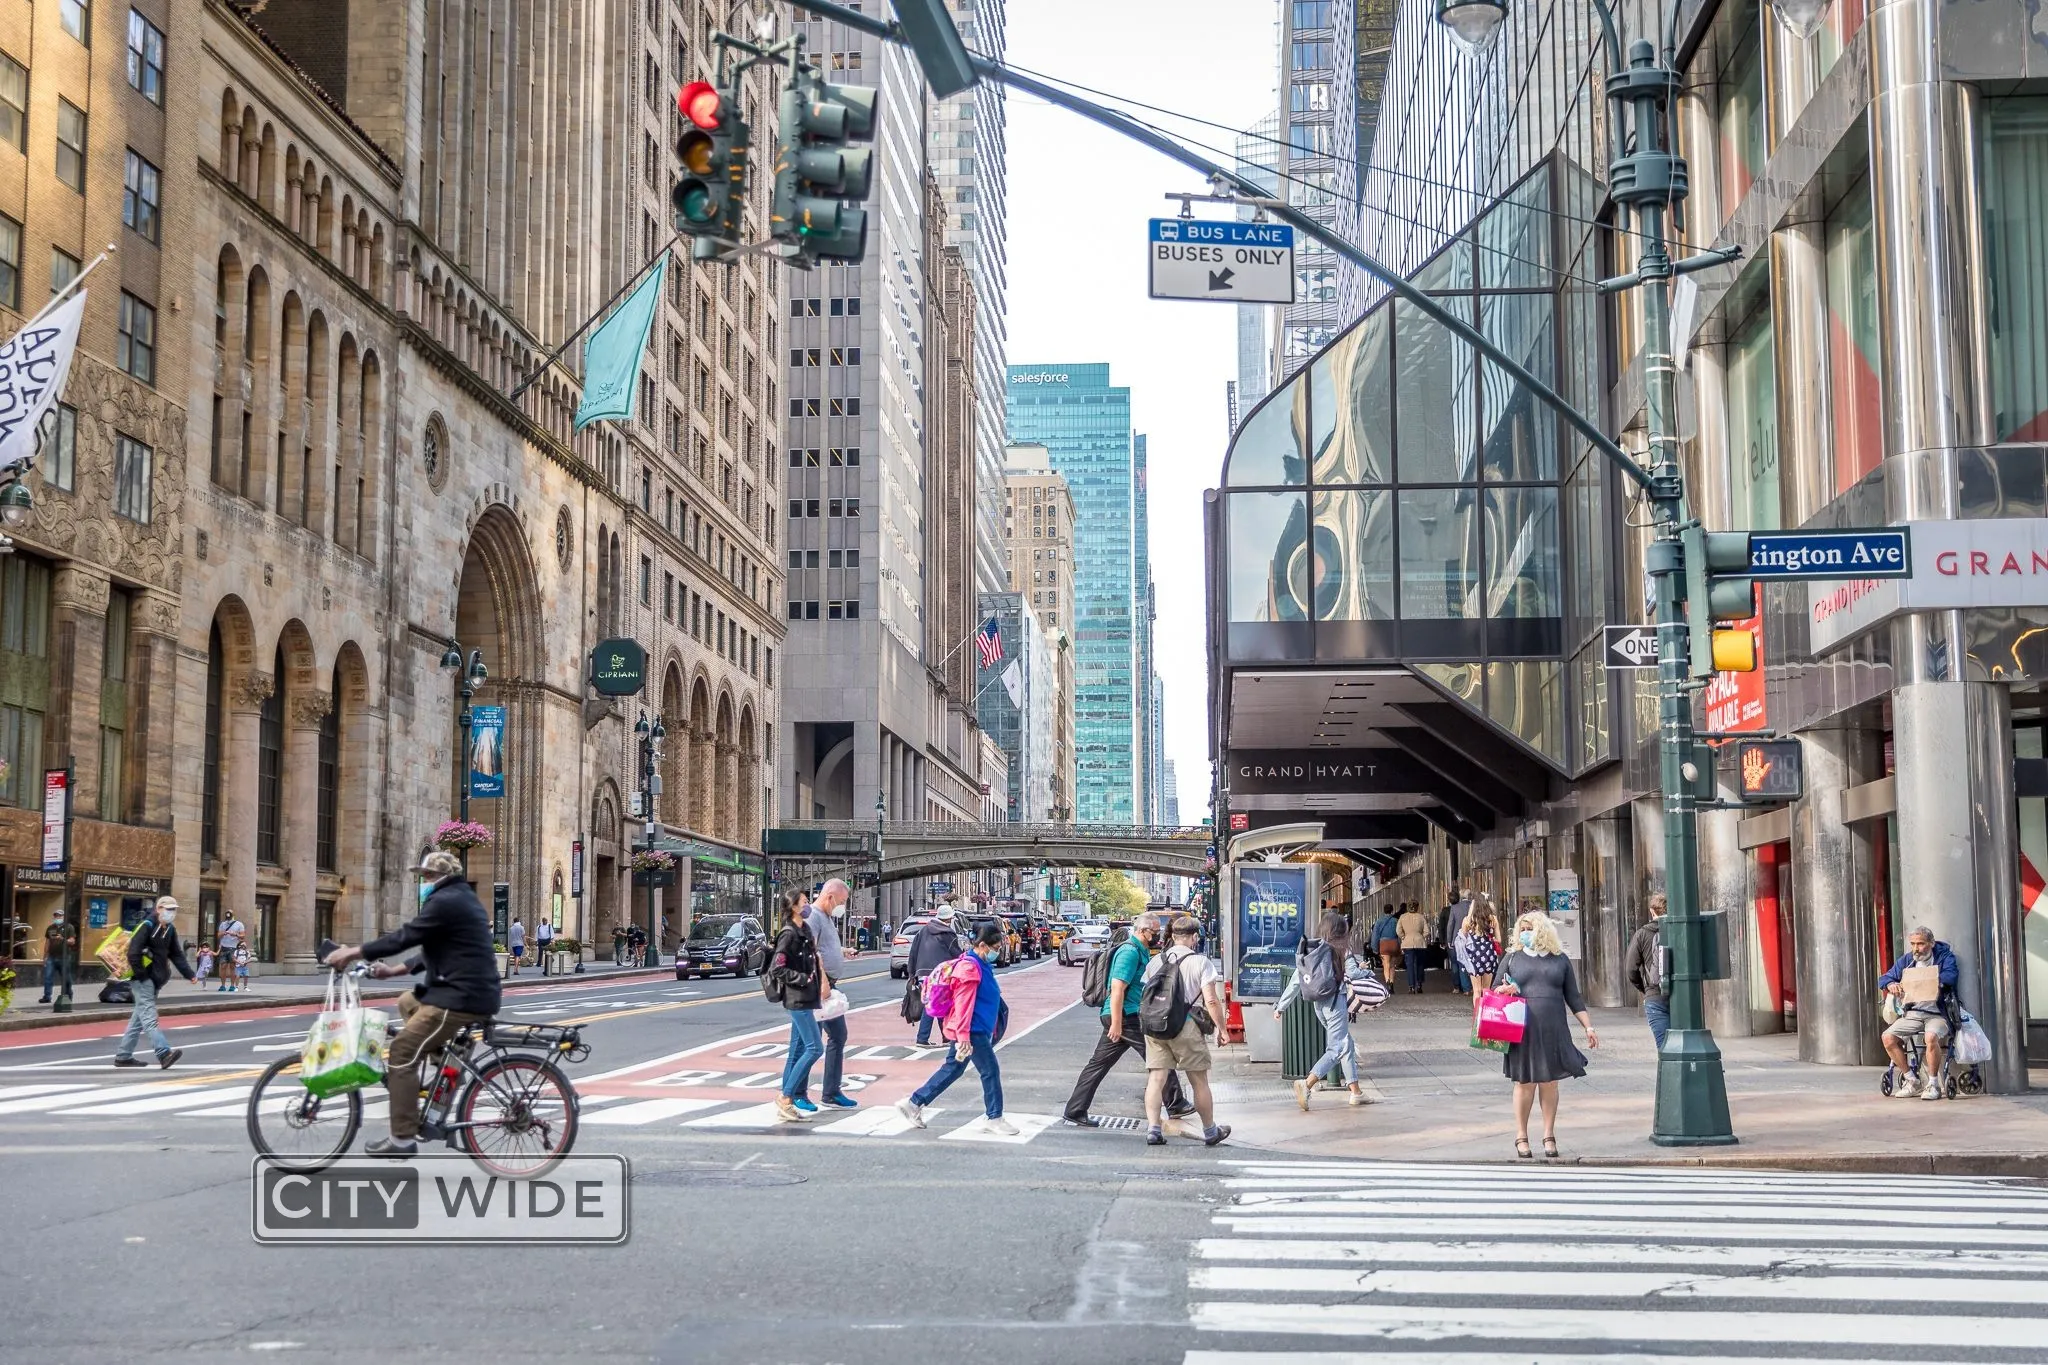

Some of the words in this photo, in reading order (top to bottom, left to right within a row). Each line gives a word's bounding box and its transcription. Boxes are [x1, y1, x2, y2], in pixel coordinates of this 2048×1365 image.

[1188, 226, 1224, 239] BUS
[1232, 228, 1283, 242] LANE
[1158, 245, 1224, 263] BUSES
[1235, 249, 1285, 265] ONLY
[1011, 372, 1069, 385] salesforce
[1850, 542, 1900, 564] Ave
[1813, 584, 1848, 623] GRAND
[1625, 639, 1658, 655] ONE
[598, 671, 638, 679] CIPRIANI
[1707, 671, 1739, 706] SPACE
[1708, 698, 1740, 733] AVAILABLE
[1240, 765, 1304, 777] GRAND
[1316, 765, 1377, 777] HYATT
[925, 852, 966, 862] SQUARE
[973, 849, 1007, 857] PLAZA
[1067, 849, 1105, 857] GRAND
[1111, 852, 1161, 862] CENTRAL
[1168, 857, 1202, 868] TERMI
[86, 874, 104, 887] APPLE
[104, 875, 121, 888] BANK
[128, 878, 152, 891] SAVINGS
[1248, 901, 1298, 917] STOPS
[1248, 915, 1298, 931] HERE
[632, 1069, 879, 1092] BUS
